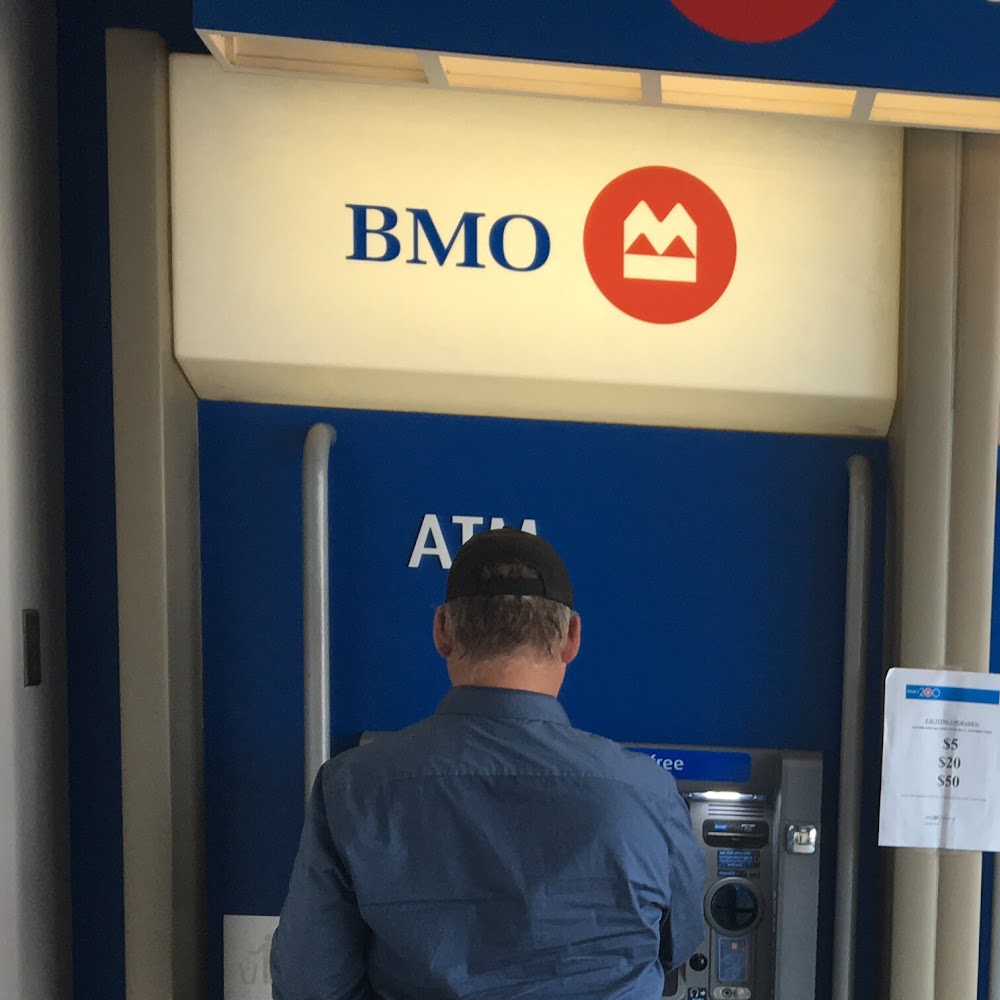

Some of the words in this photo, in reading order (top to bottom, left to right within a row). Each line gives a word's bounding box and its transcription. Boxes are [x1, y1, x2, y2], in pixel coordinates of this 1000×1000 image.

[345, 203, 550, 271] BMO
[942, 737, 959, 751] $5
[938, 756, 961, 770] $20
[937, 774, 960, 788] $50
